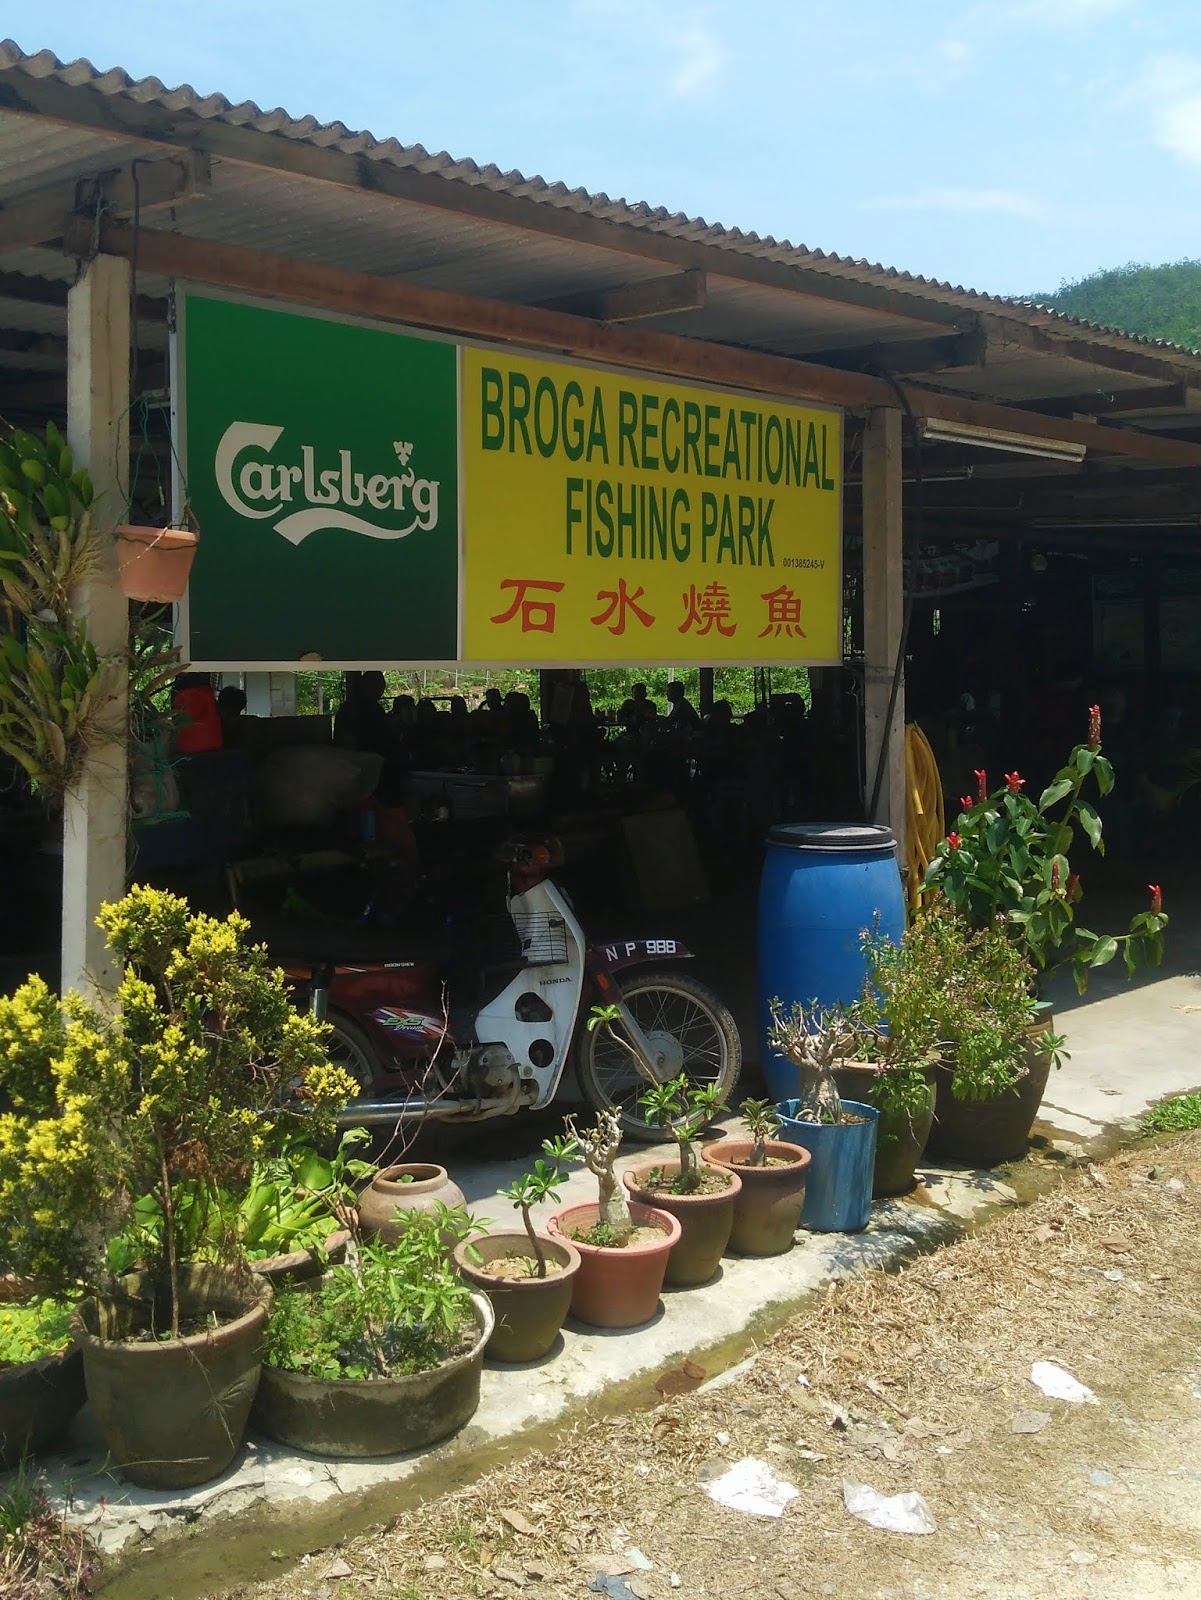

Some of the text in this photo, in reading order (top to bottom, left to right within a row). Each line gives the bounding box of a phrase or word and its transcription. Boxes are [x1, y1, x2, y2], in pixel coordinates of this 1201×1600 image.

[481, 366, 835, 491] BROGA RECREATIONAL
[215, 420, 440, 546] Carlsberg
[566, 477, 776, 567] FISHING PARK
[490, 577, 807, 638] 石水燒魚
[539, 977, 571, 986] HONDA
[645, 939, 677, 954] 988
